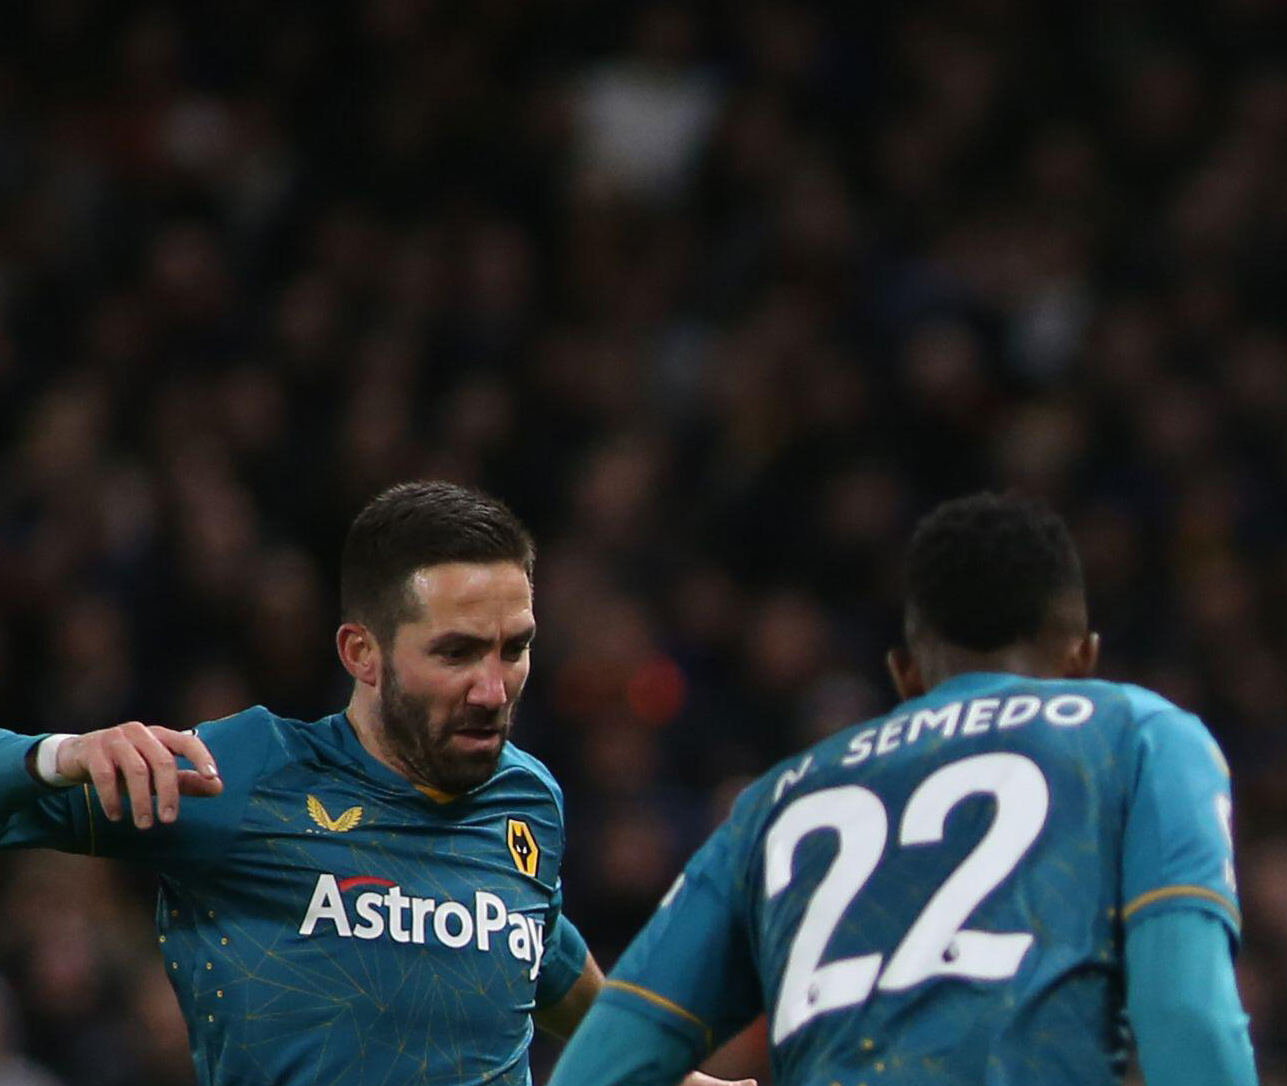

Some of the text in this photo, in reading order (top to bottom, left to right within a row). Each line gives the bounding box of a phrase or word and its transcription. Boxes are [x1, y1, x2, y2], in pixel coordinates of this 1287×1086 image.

[843, 695, 1094, 767] SEMEDO
[299, 874, 543, 981] AstroPay
[764, 752, 1050, 1046] 22
